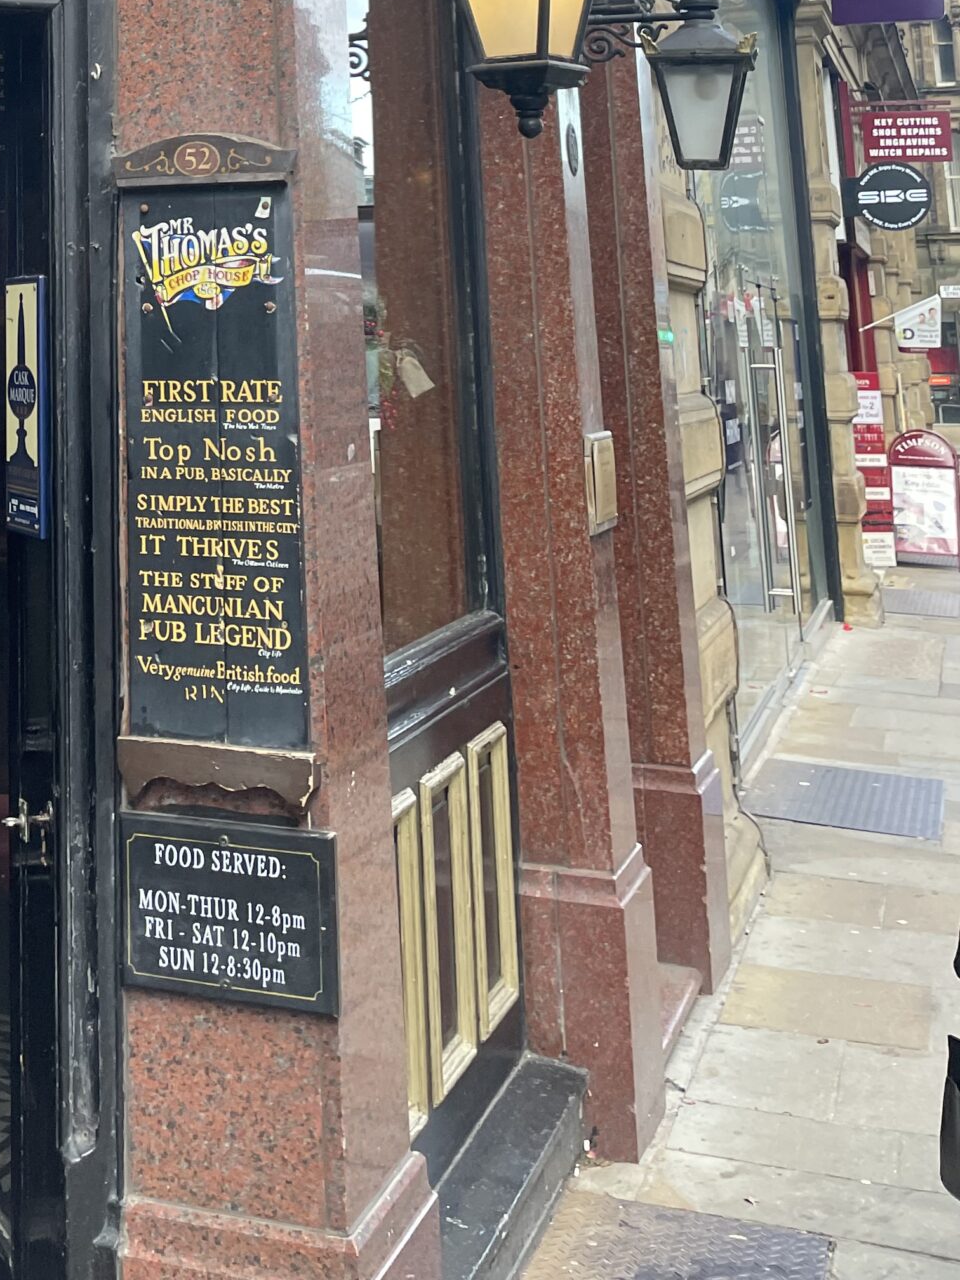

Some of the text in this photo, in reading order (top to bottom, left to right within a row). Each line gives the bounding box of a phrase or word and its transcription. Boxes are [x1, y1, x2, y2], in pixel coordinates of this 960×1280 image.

[872, 127, 942, 136] SHOE REPAIRS
[873, 117, 939, 126] KEY CUTTING
[869, 147, 948, 157] WATCH REPAIRS
[879, 138, 936, 147] ENGRAVING
[184, 147, 211, 170] 52
[169, 217, 194, 236] MR
[140, 222, 268, 283] THOMAS'S
[168, 268, 250, 289] CHOP HOUSE
[14, 370, 29, 386] CASK
[10, 387, 35, 404] MARQUE
[143, 380, 283, 403] FIRST RATE
[141, 408, 280, 423] ENGLISH FOOD
[143, 436, 277, 465] Top Nosh
[895, 438, 946, 455] TIMPSON
[141, 467, 292, 483] IN A PUB, BASICALLY
[137, 494, 294, 516] SIMPLY THE BEST
[135, 516, 205, 530] TRADITIONAL
[245, 521, 255, 531] IN
[256, 521, 275, 533] THE
[277, 522, 298, 534] CITY
[139, 534, 279, 560] IT THRIVES
[139, 570, 284, 593] THE STUFF OF
[142, 593, 284, 620] MANCUNIAN
[138, 619, 292, 651] PUB LEGEND
[136, 655, 301, 685] Very genuine British food
[154, 843, 287, 879] FOOD SERVED:
[139, 888, 306, 934] MON-THUR 12-8pm
[144, 916, 173, 941] FRI
[192, 922, 224, 947] SAT
[233, 928, 301, 962] 12-10pm
[158, 946, 286, 988] SUN 12-8:30pm
